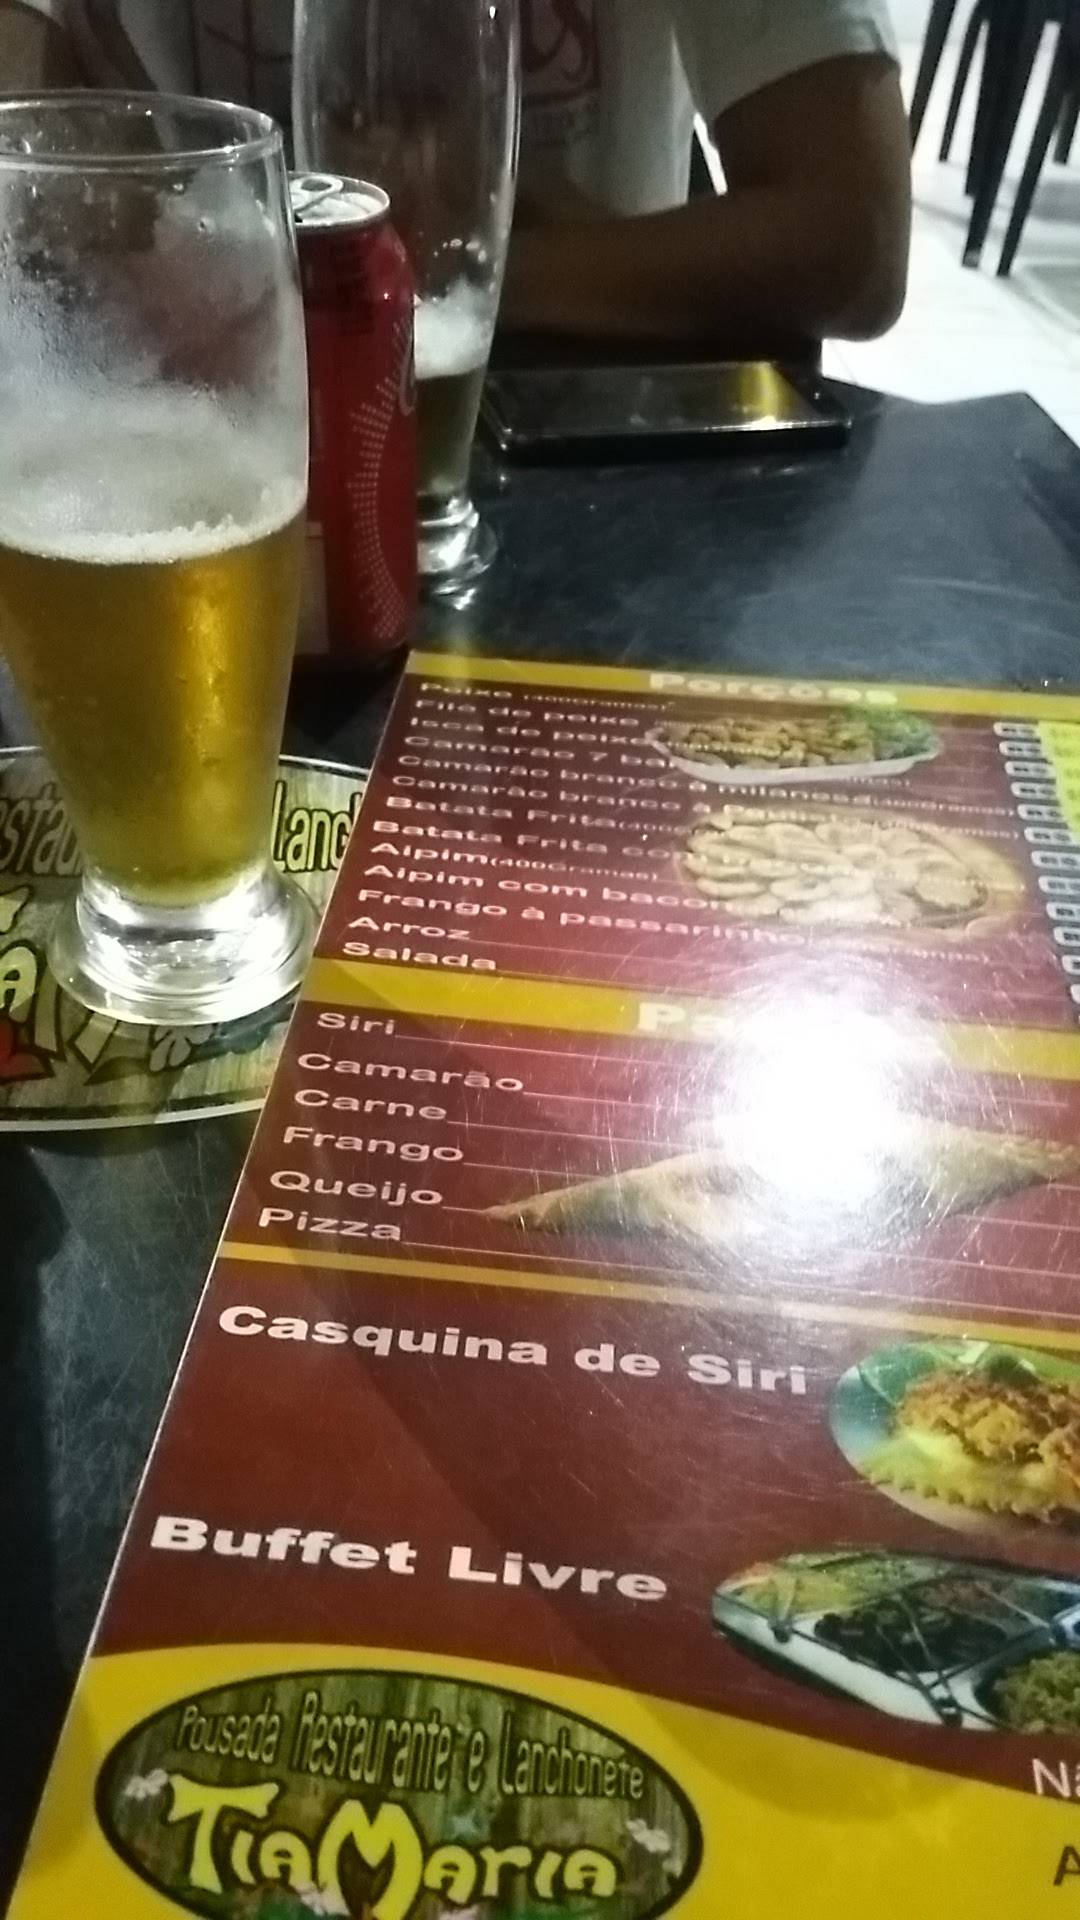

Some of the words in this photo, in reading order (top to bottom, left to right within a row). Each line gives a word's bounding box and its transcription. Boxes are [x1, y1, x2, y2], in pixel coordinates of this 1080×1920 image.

[488, 706, 532, 717] de
[544, 711, 639, 726] peixe
[405, 736, 575, 758] Camarão
[496, 725, 540, 737] de
[553, 731, 651, 746] peixe
[399, 755, 549, 778] Camarão
[560, 769, 678, 790] branco
[386, 796, 513, 819] Batata
[393, 775, 548, 798] Camarão
[559, 789, 681, 811] branco
[373, 820, 502, 843] Batata
[517, 834, 608, 855] Frita
[498, 880, 588, 898] com
[348, 916, 471, 941] Arroz
[358, 889, 508, 916] Frango
[560, 912, 806, 944] passarinho
[343, 941, 497, 971] Salada
[316, 1012, 395, 1036] Siri
[297, 1053, 524, 1092] Camarão
[294, 1089, 447, 1121] Carne
[282, 1126, 464, 1162] Frango
[269, 1170, 443, 1206] Queijo
[257, 1207, 402, 1241] Pizza
[218, 1305, 549, 1366] Casquina
[574, 1343, 661, 1377] de
[686, 1354, 807, 1395] Siri
[150, 1515, 418, 1575] Buffet
[448, 1547, 667, 1600] Livre
[176, 1696, 281, 1765] Pousada
[292, 1690, 451, 1792] Restaurante
[502, 1709, 646, 1799] Lanchonete
